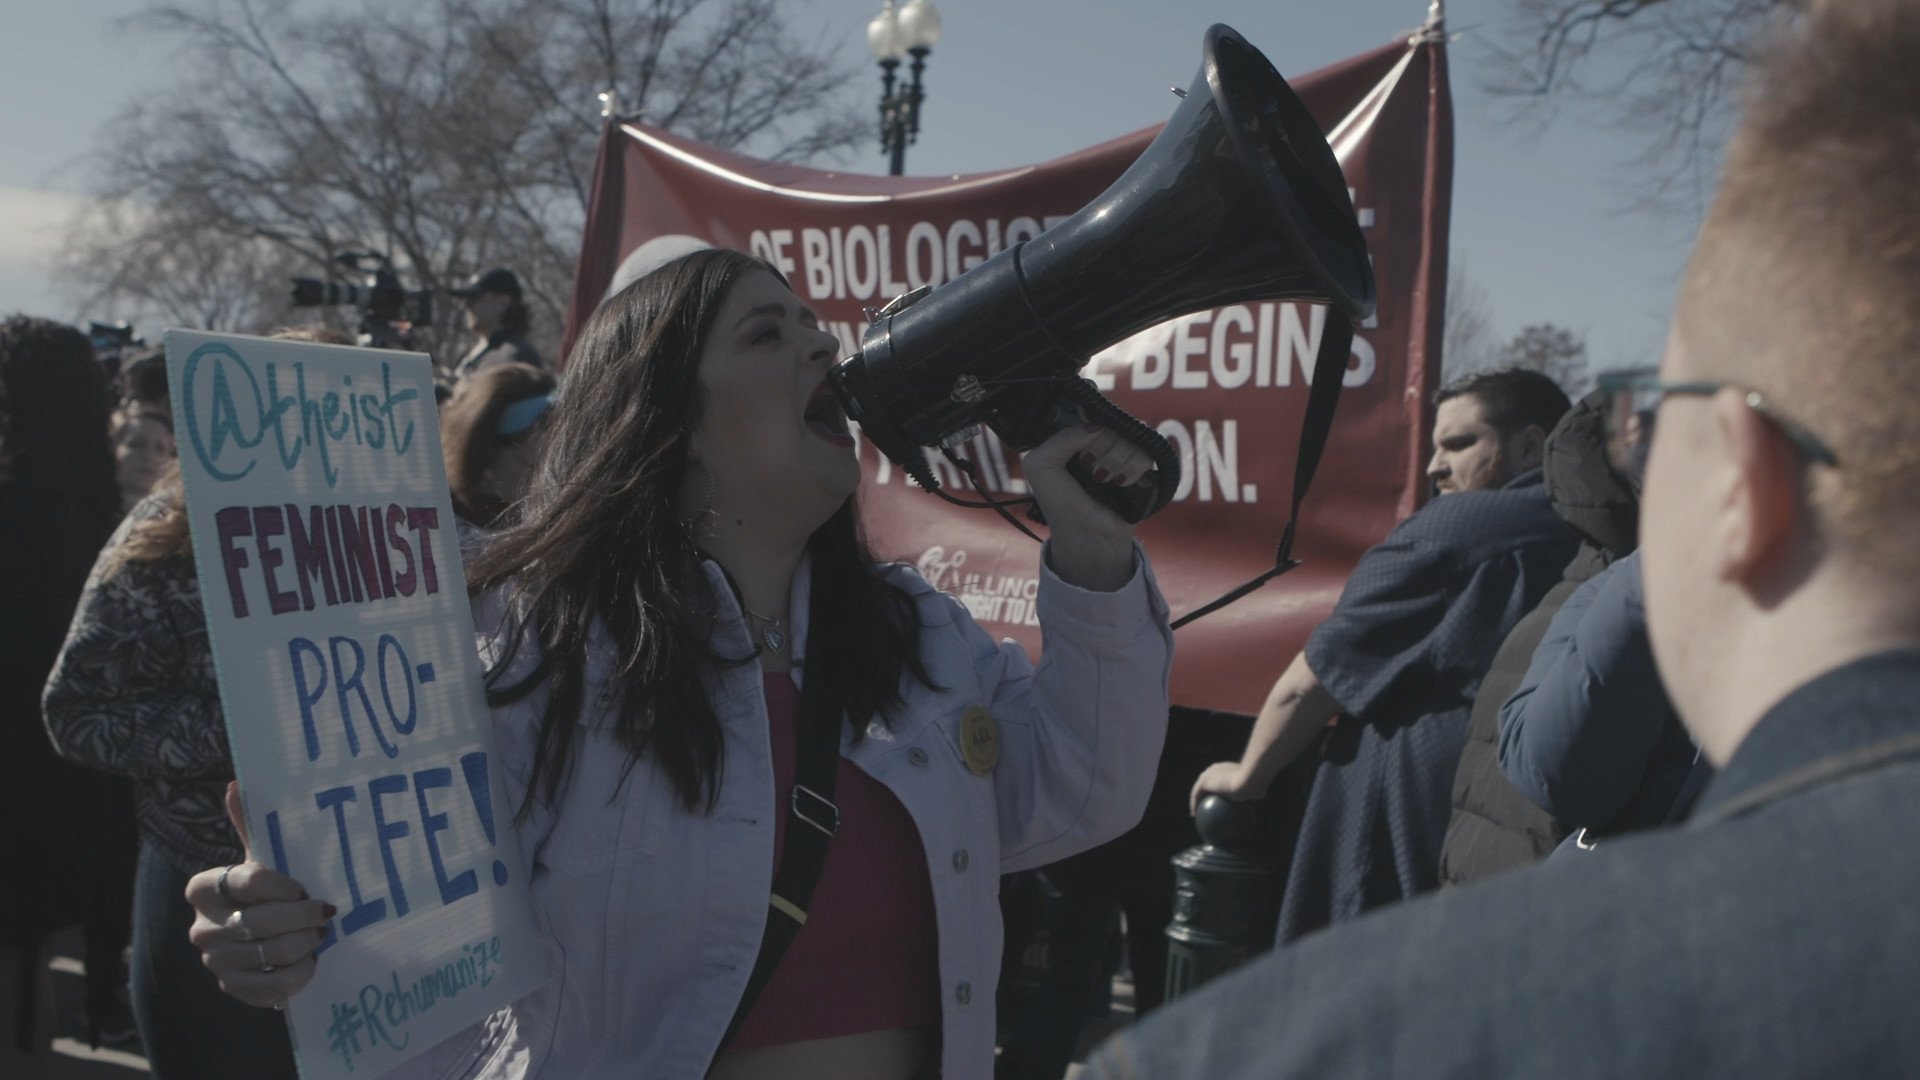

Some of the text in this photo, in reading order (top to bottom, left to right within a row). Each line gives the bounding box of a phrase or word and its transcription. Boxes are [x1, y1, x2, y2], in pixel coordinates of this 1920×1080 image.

[215, 503, 439, 618] FEMINIST
[1004, 597, 1028, 624] TO
[288, 634, 436, 762] PRO-
[327, 935, 501, 1073] #Rehumanize
